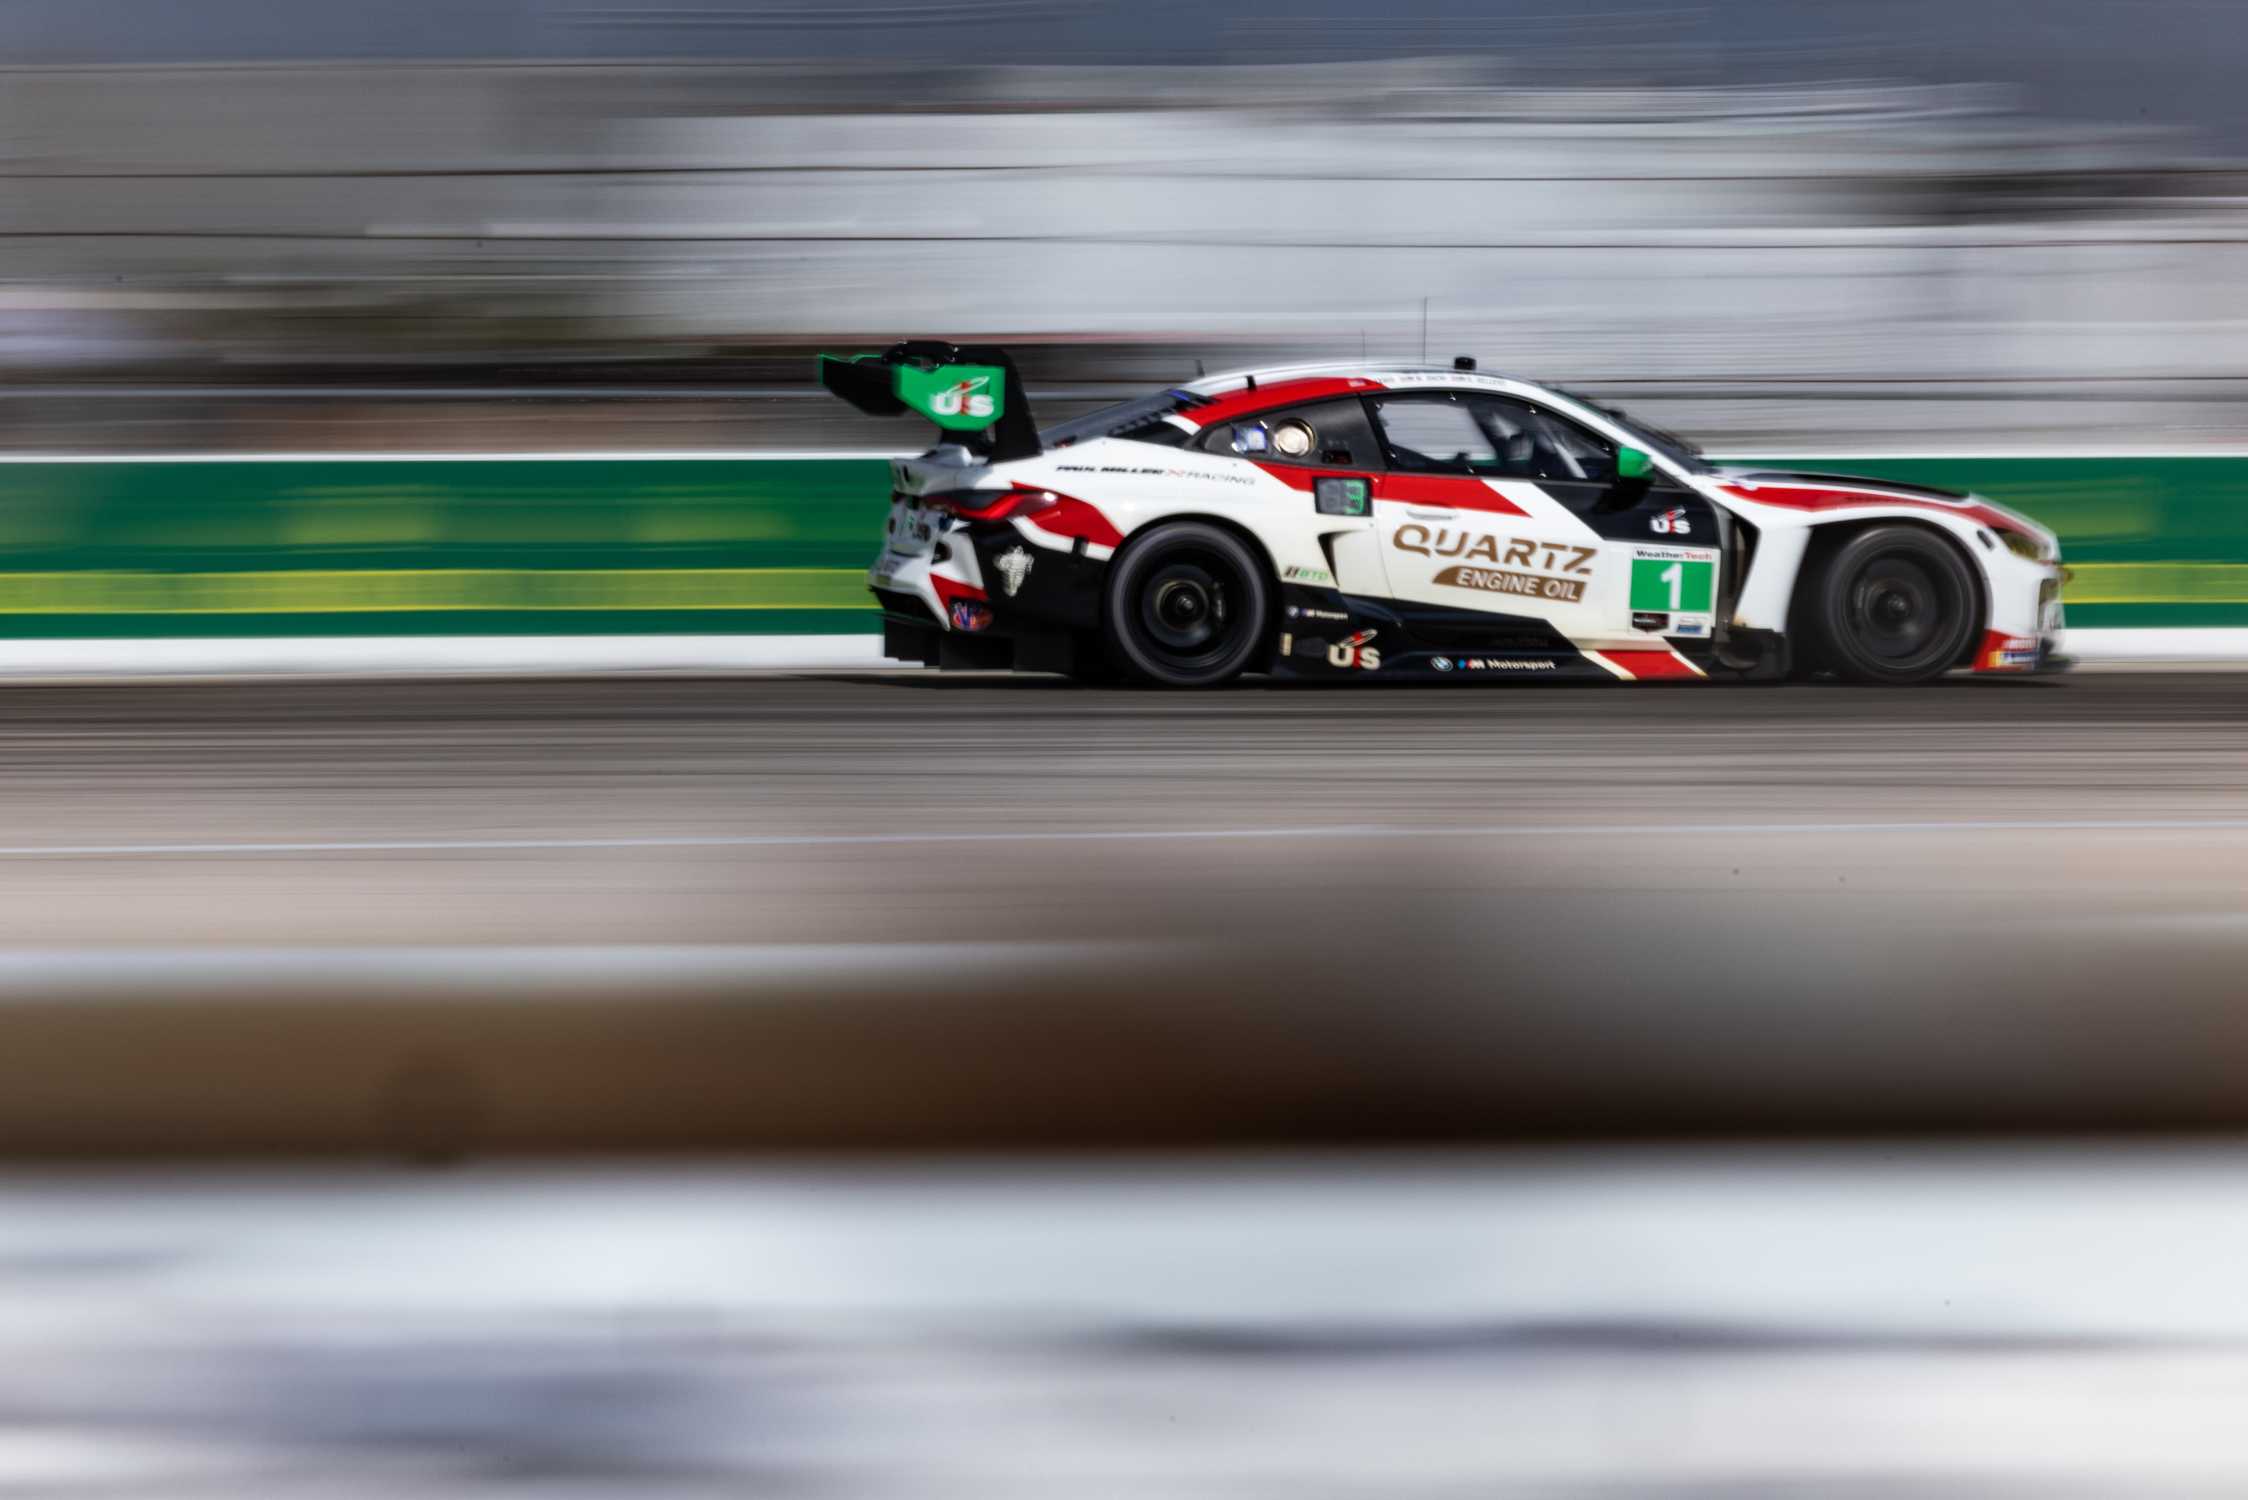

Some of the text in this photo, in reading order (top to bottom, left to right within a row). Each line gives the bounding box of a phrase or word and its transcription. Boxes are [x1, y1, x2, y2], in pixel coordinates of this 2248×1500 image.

[1393, 524, 1597, 574] QUARTZ
[1636, 550, 1712, 560] WeatherTech
[1456, 569, 1578, 600] ENGINE OIL
[1661, 562, 1682, 610] 1
[1487, 659, 1556, 670] Motorsport
